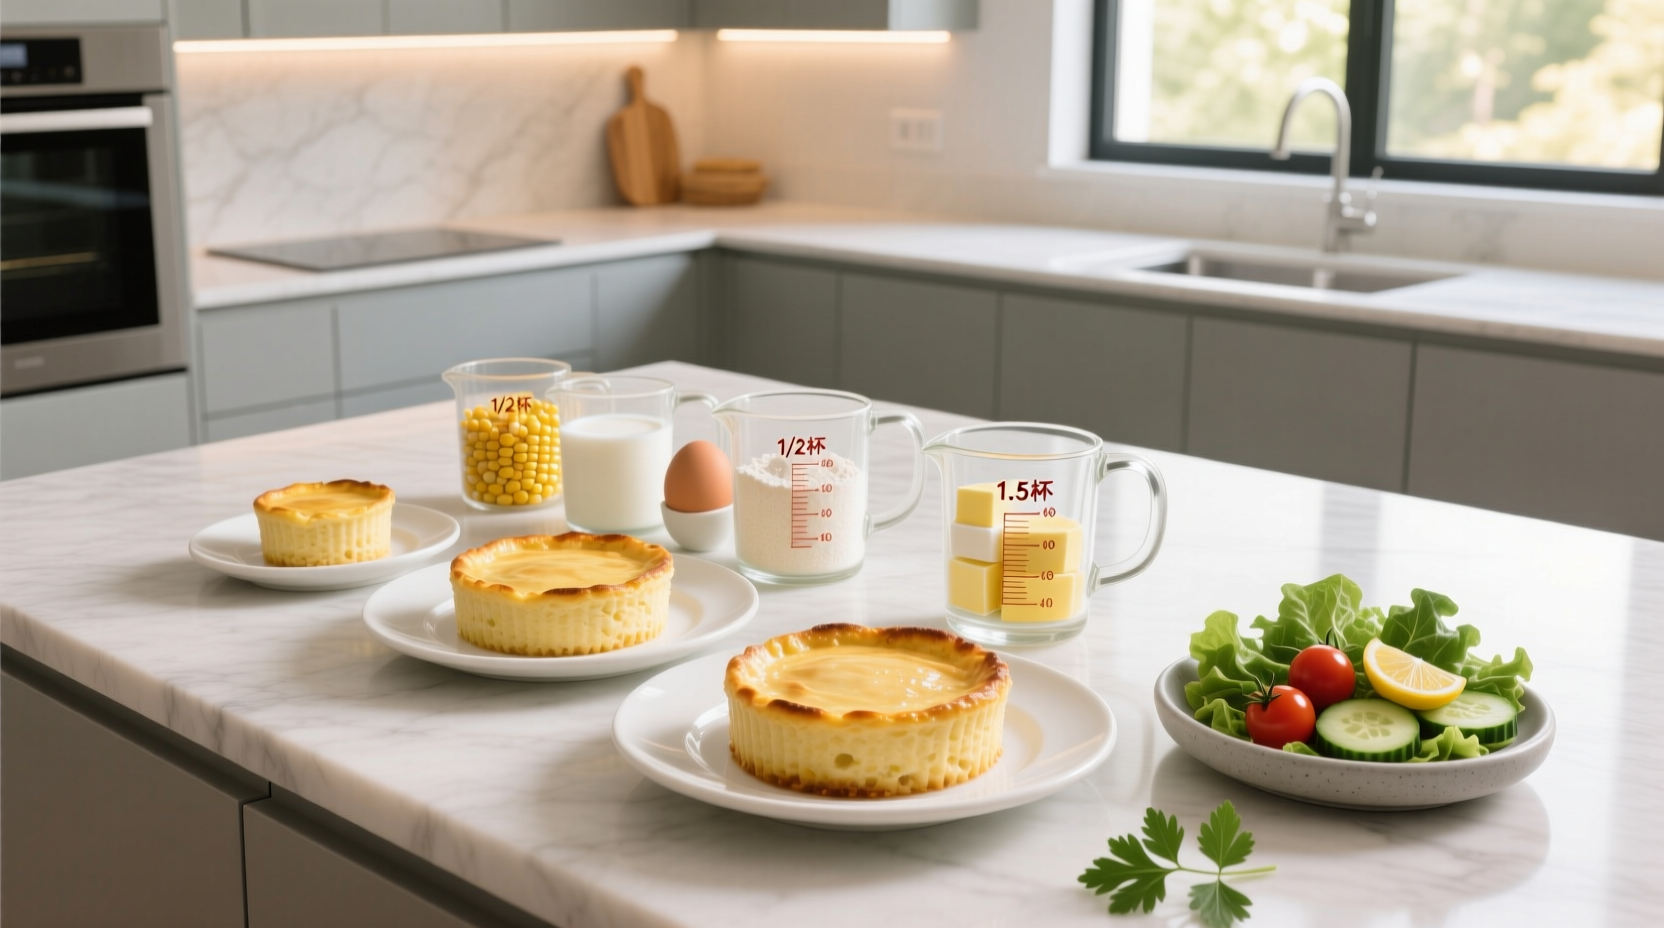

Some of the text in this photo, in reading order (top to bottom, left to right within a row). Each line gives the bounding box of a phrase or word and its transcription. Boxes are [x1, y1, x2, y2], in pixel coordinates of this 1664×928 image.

[491, 395, 532, 414] 1/2杯
[777, 436, 826, 458] 1/2杯
[997, 479, 1054, 503] 1.5杯
